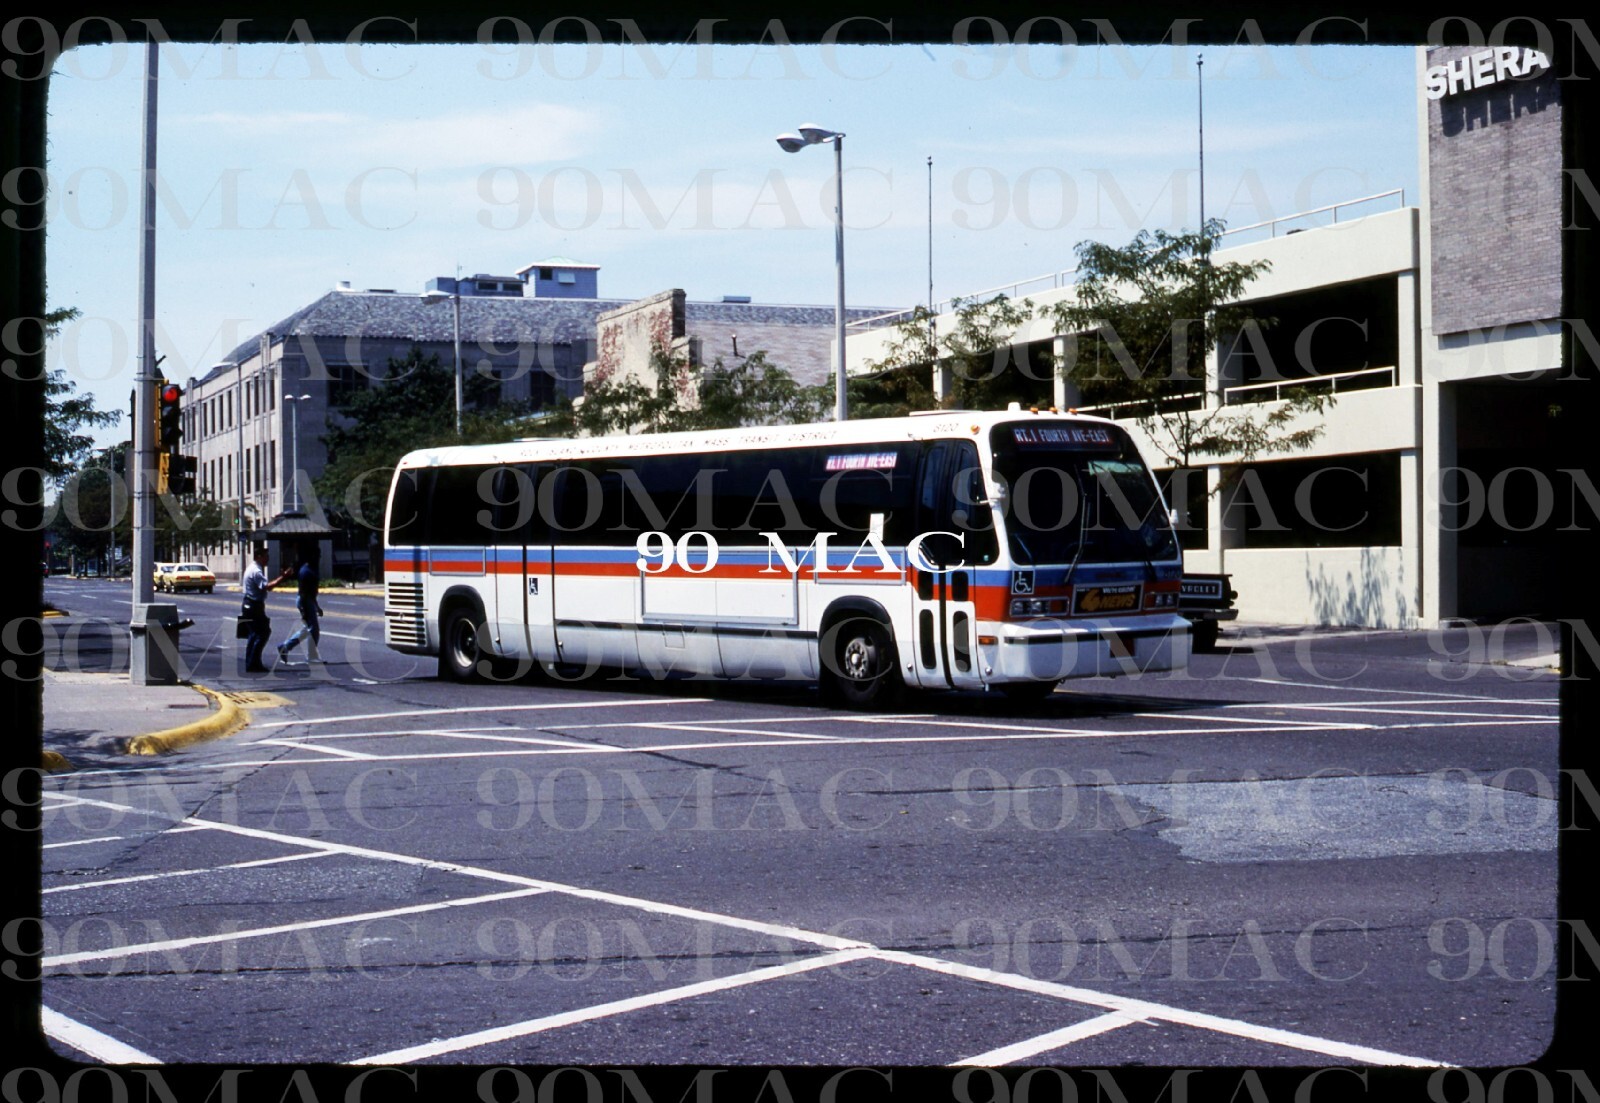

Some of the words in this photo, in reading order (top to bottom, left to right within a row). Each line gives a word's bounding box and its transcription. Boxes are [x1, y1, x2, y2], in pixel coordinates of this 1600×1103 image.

[1424, 46, 1550, 100] SHERA
[787, 430, 838, 442] DISTRICT
[1038, 429, 1070, 442] FOURTH
[1099, 594, 1136, 608] NEWS
